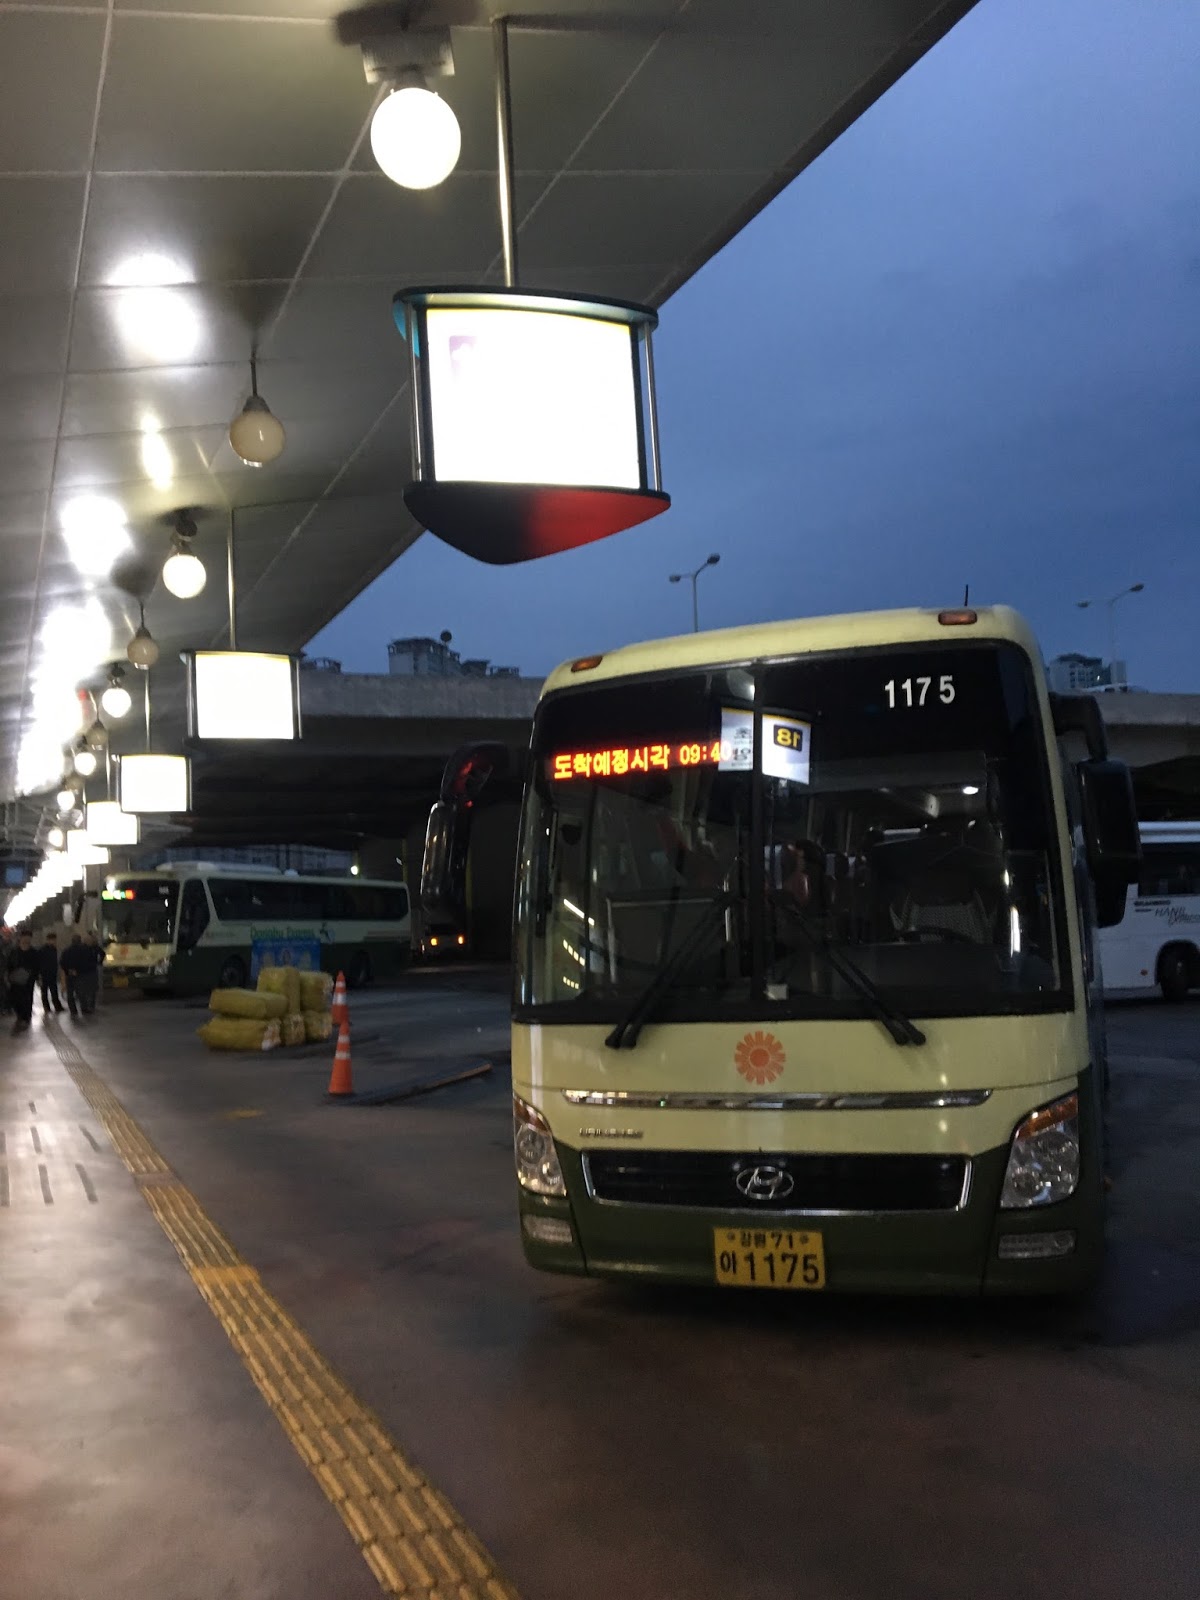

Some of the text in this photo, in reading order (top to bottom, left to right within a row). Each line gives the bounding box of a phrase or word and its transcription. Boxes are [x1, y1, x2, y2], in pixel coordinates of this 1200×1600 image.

[884, 674, 956, 708] 1175
[553, 744, 670, 779] 도착예정시각
[771, 1232, 793, 1249] 71
[743, 1251, 819, 1284] 1175
